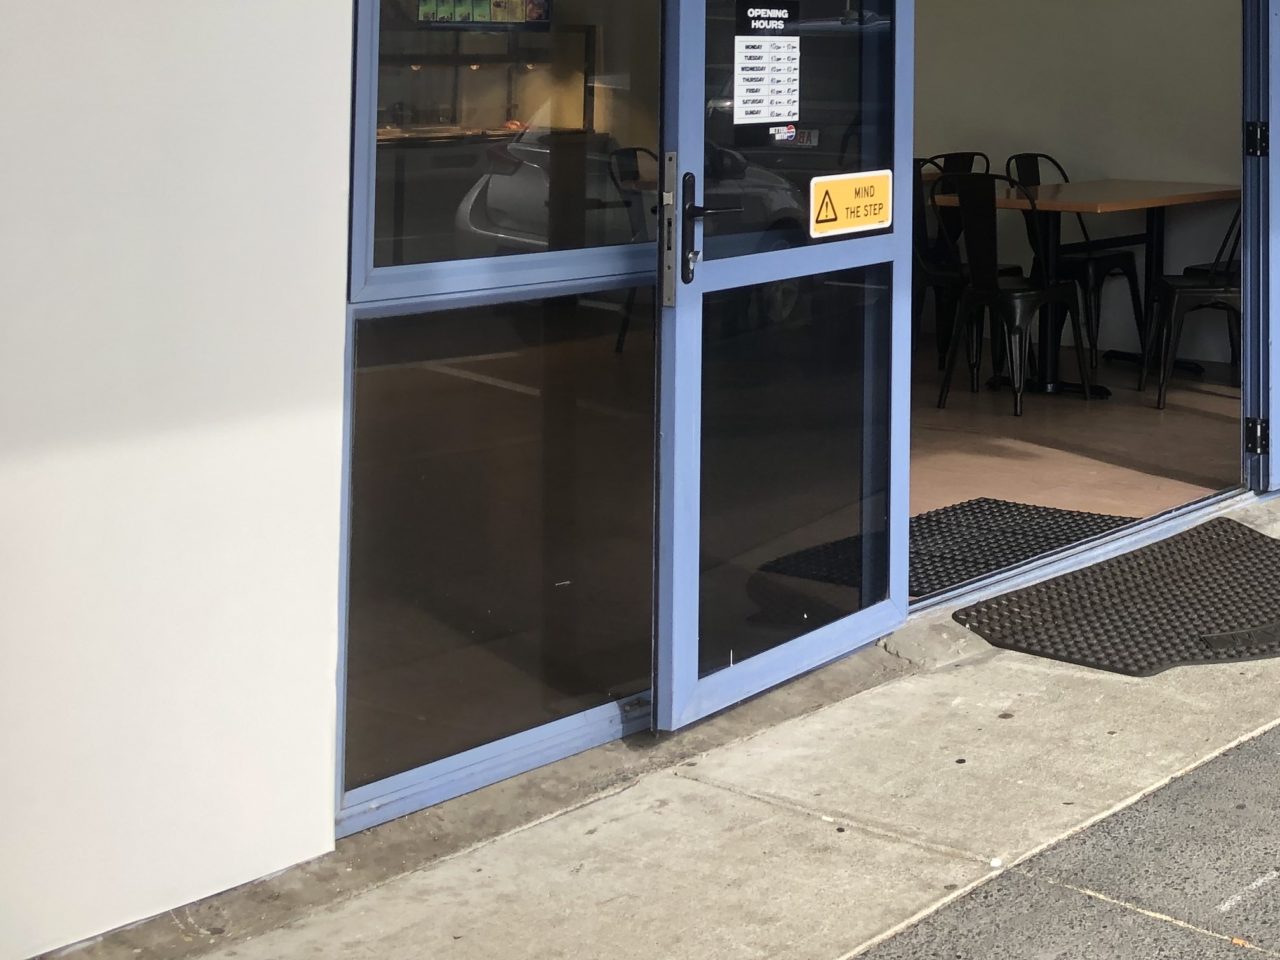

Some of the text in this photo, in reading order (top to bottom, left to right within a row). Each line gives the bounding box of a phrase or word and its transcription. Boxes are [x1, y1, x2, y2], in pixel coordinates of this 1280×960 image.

[747, 8, 789, 19] OPENING
[751, 20, 785, 30] HOURS
[854, 185, 876, 200] MIND
[845, 202, 884, 220] THE STEP
